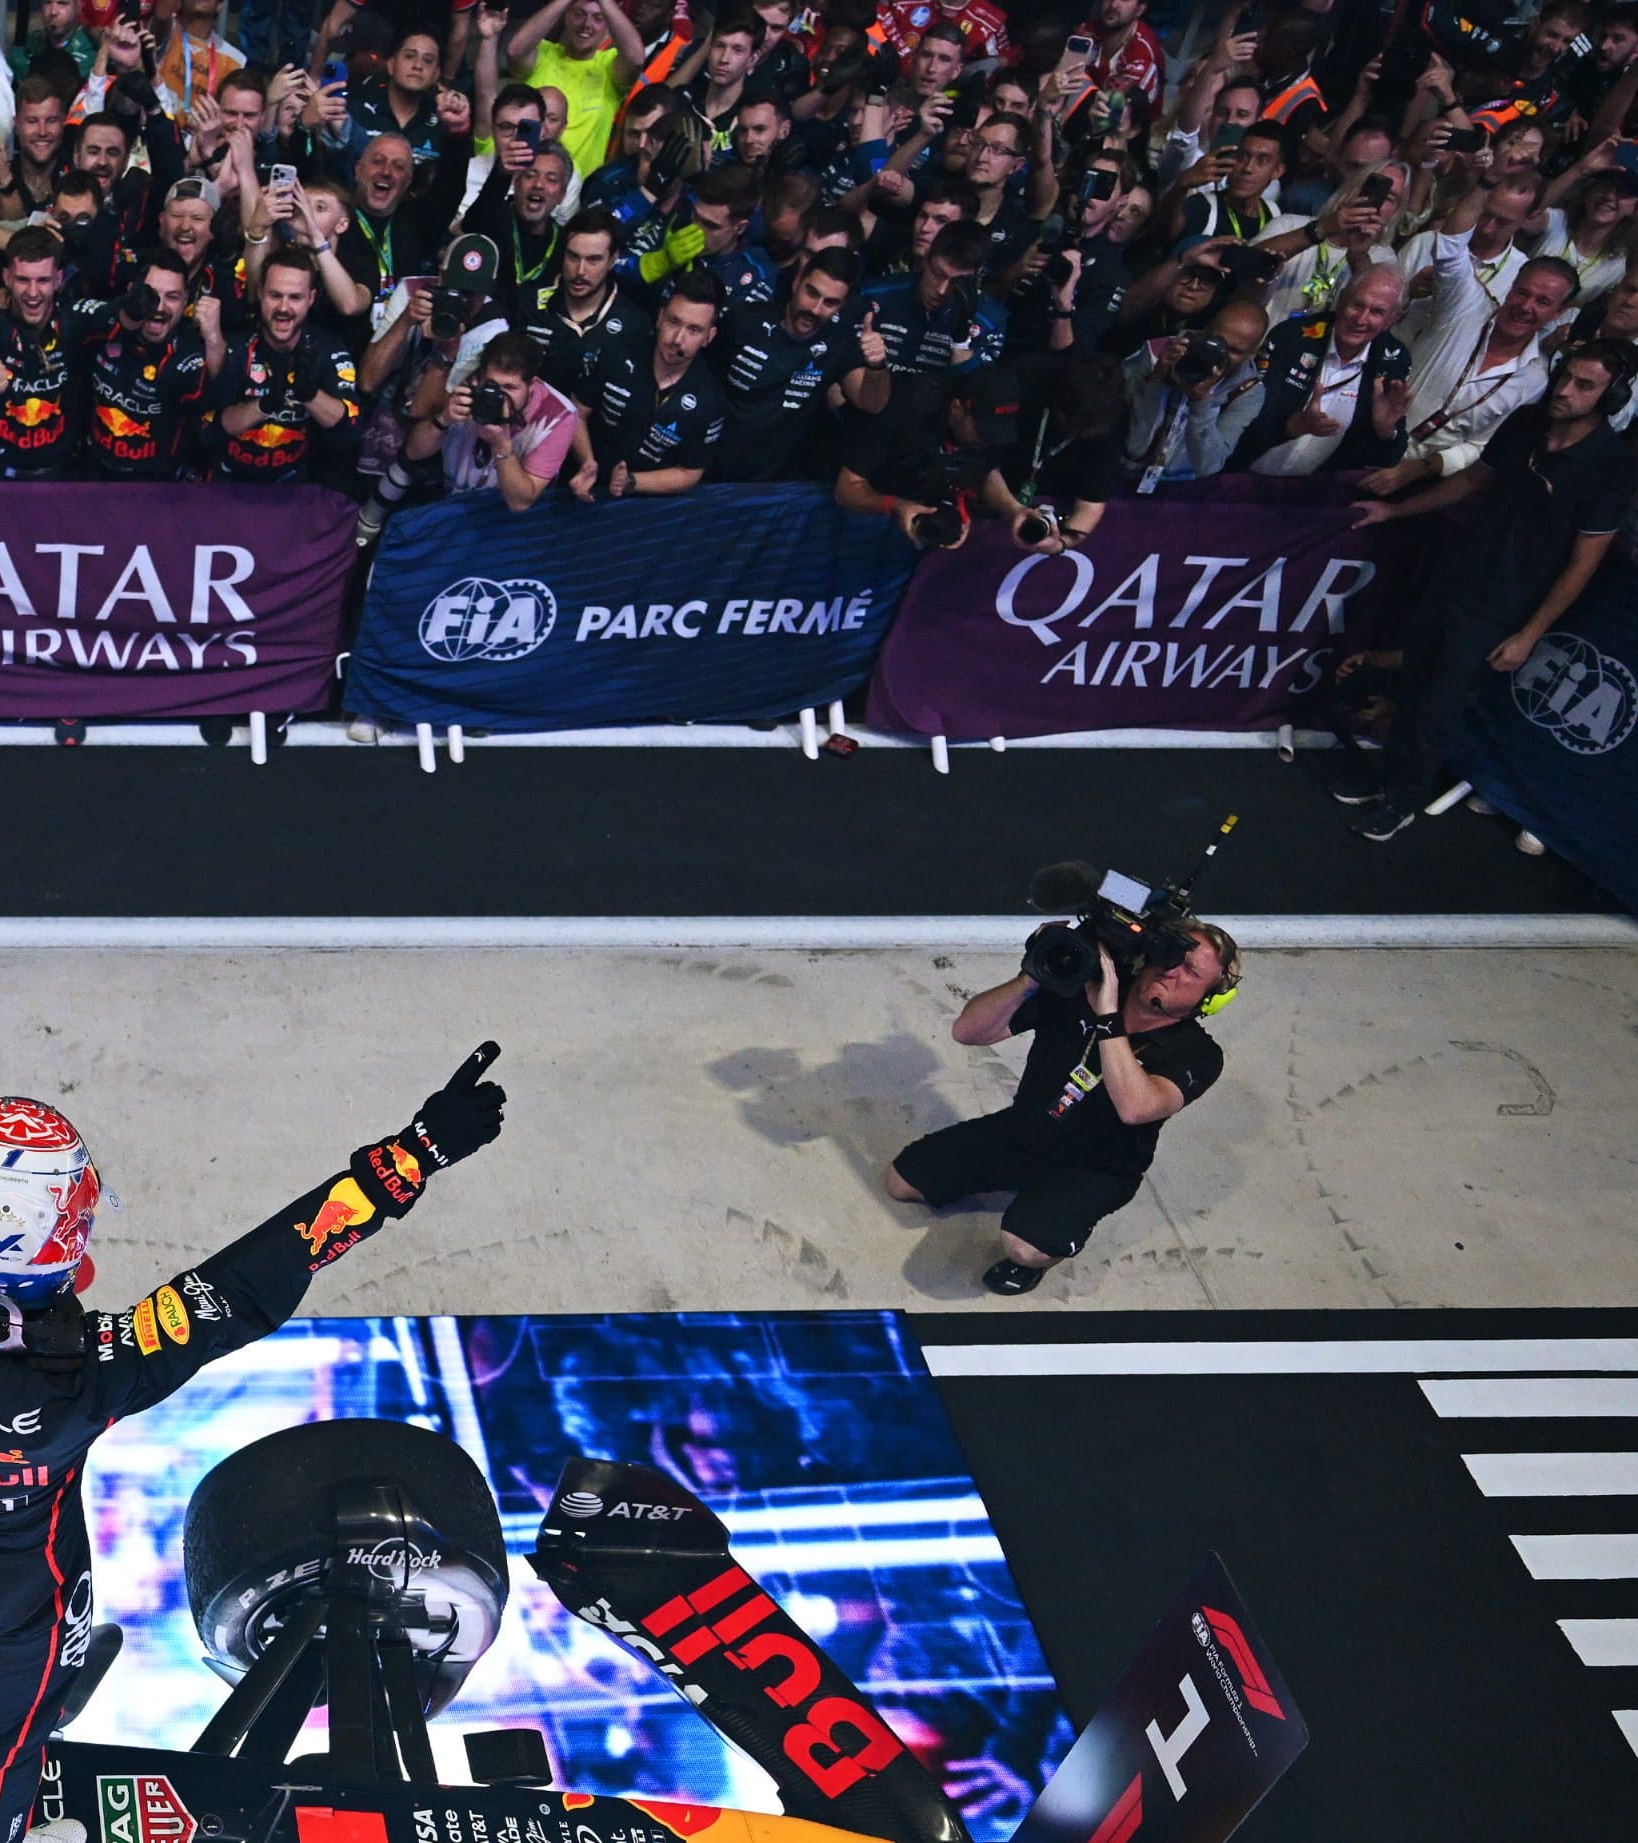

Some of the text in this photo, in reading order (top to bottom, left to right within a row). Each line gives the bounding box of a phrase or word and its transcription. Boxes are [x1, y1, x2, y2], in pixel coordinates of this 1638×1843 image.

[114, 439, 158, 461] Bull
[575, 599, 709, 643] PARC
[716, 588, 873, 636] FERMÉ
[994, 549, 1377, 647] QATAR
[1040, 640, 1334, 695] AIRWAYS
[368, 1146, 415, 1204] Red Bull
[162, 1290, 182, 1328] RAUCH
[606, 1501, 694, 1522] AT&T
[346, 1547, 442, 1571] Hard Rock
[640, 1566, 905, 1800] Bull
[1206, 1648, 1256, 1750] World Championship
[1217, 1661, 1239, 1702] Formula
[42, 1759, 64, 1822] CLE
[107, 1784, 135, 1843] AG
[145, 1780, 185, 1843] UER
[469, 1809, 490, 1843] T&T
